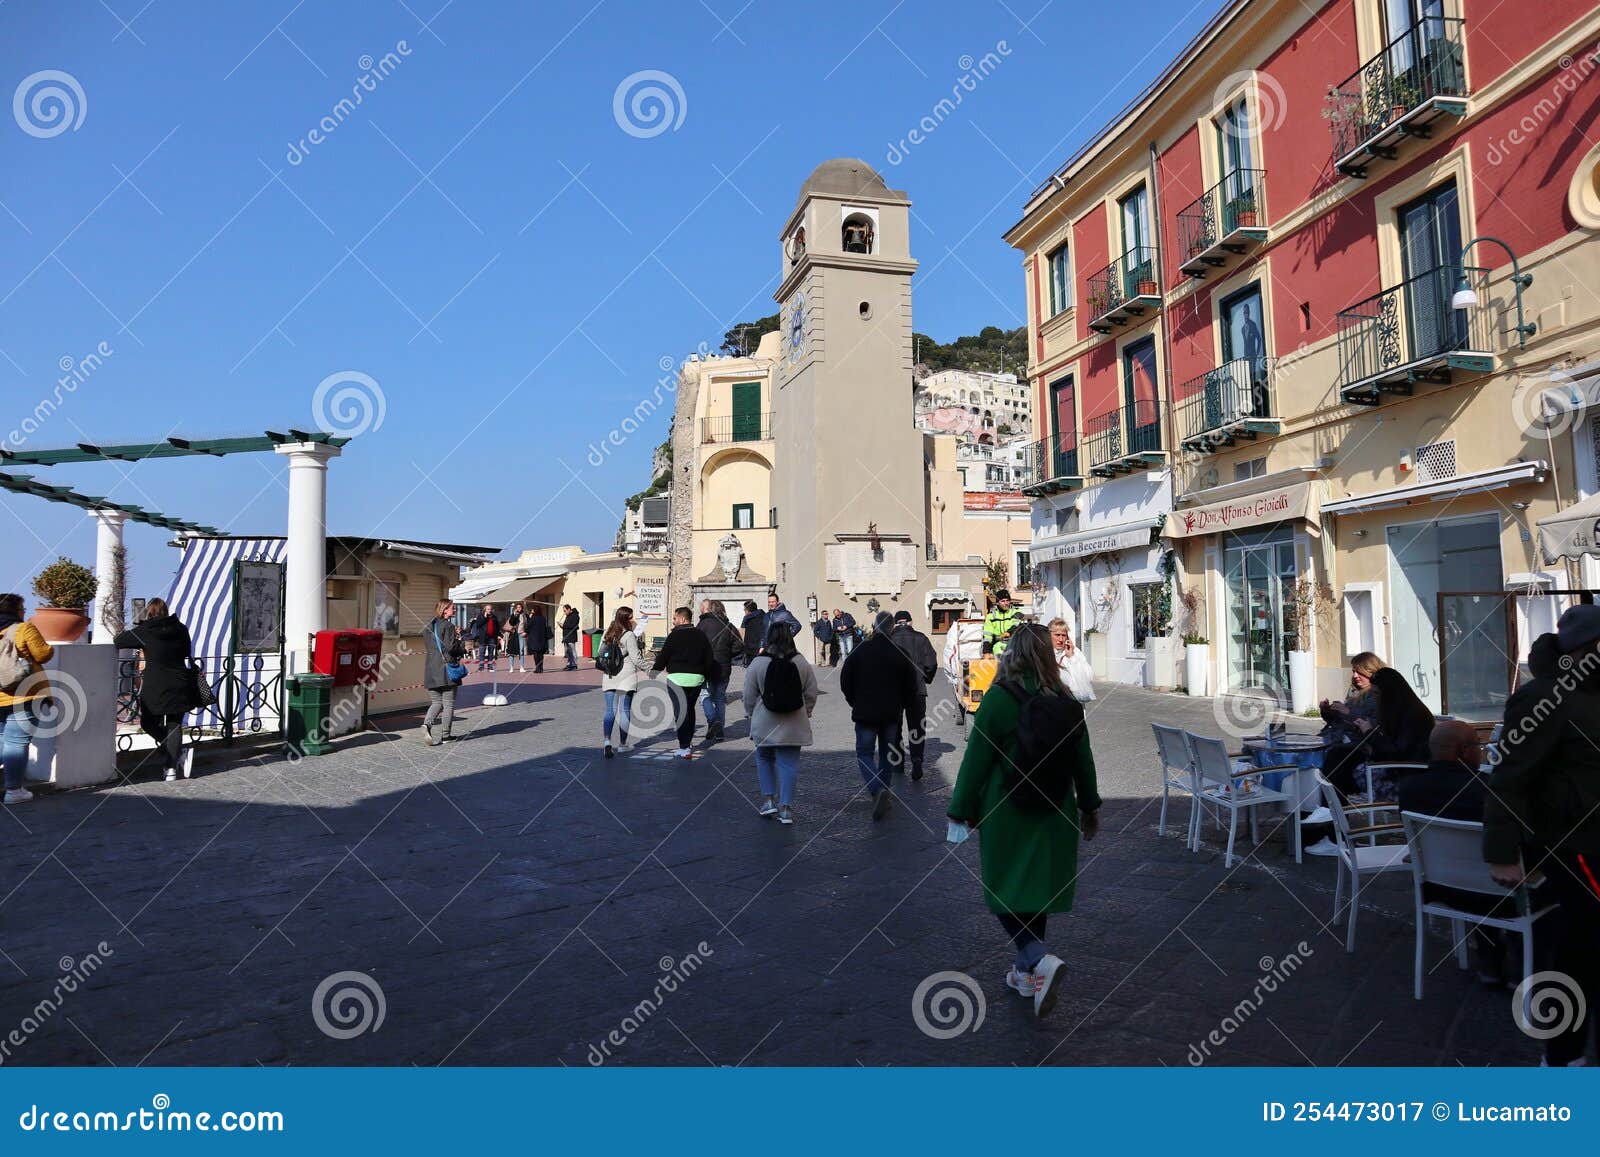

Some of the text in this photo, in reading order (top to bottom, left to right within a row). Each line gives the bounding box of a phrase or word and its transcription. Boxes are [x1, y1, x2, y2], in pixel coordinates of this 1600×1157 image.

[1254, 494, 1289, 517] Gioielli
[1053, 537, 1116, 556] Luisa Beccaria
